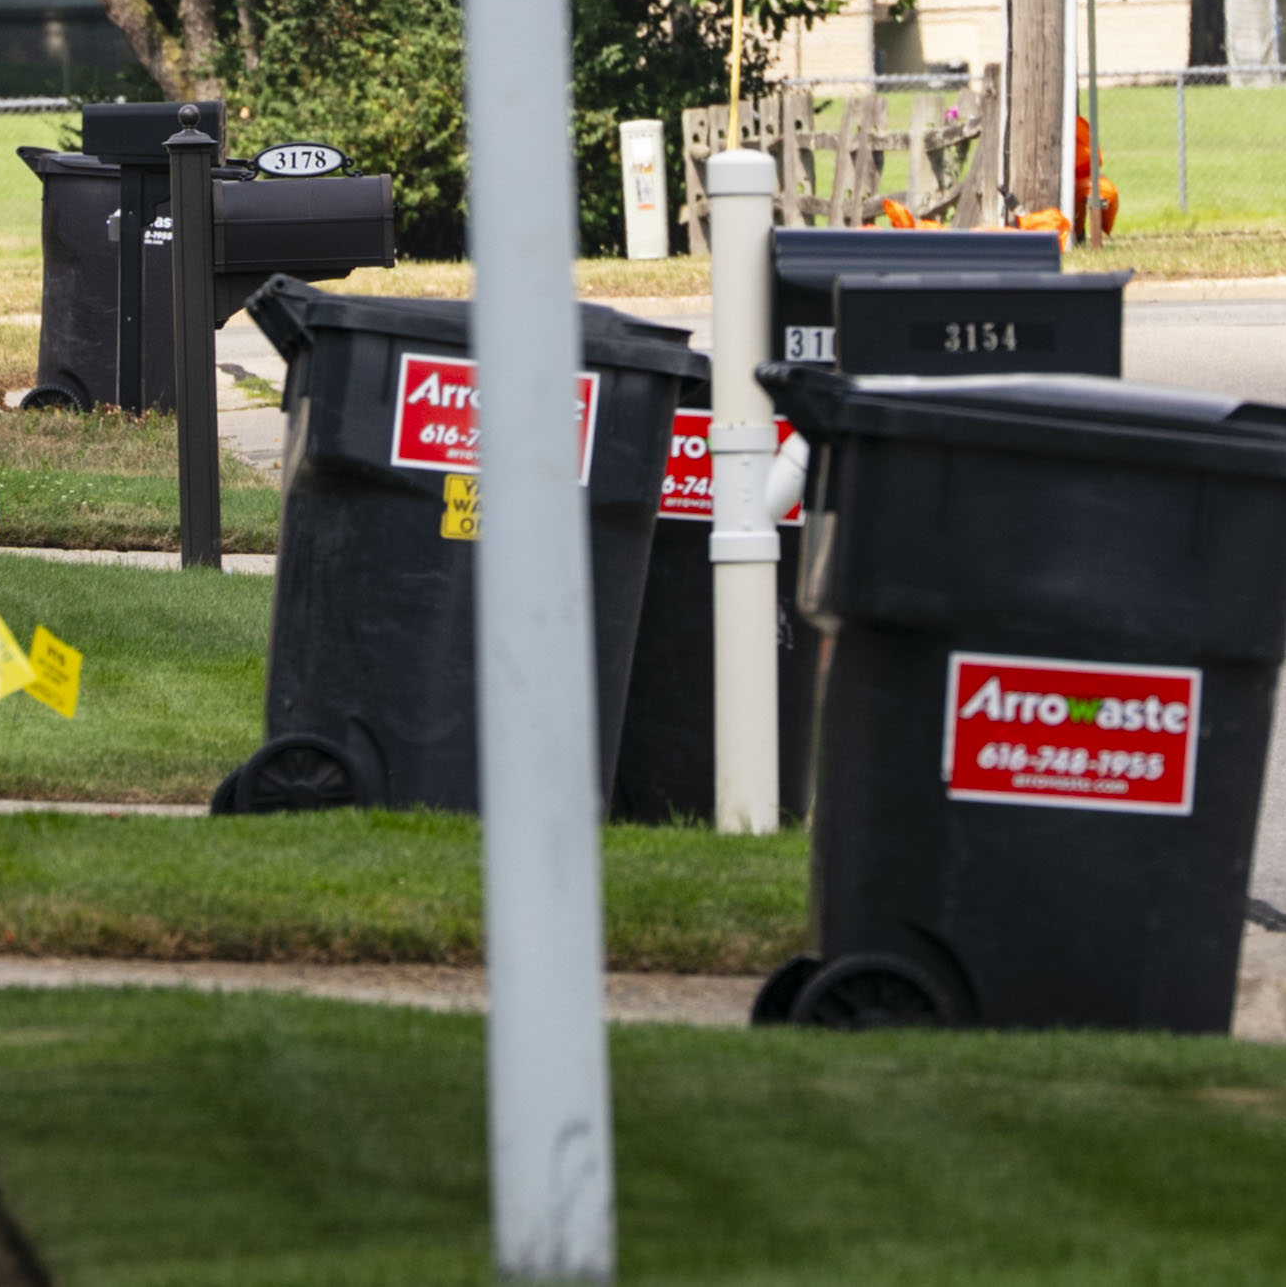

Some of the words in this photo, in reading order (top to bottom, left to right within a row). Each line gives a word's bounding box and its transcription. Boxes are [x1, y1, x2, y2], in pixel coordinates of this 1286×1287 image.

[274, 150, 327, 170] 3178
[790, 329, 831, 358] 31
[944, 322, 1017, 352] 3154
[958, 675, 1189, 735] Arrowaste
[976, 741, 1165, 782] 616-748-1955
